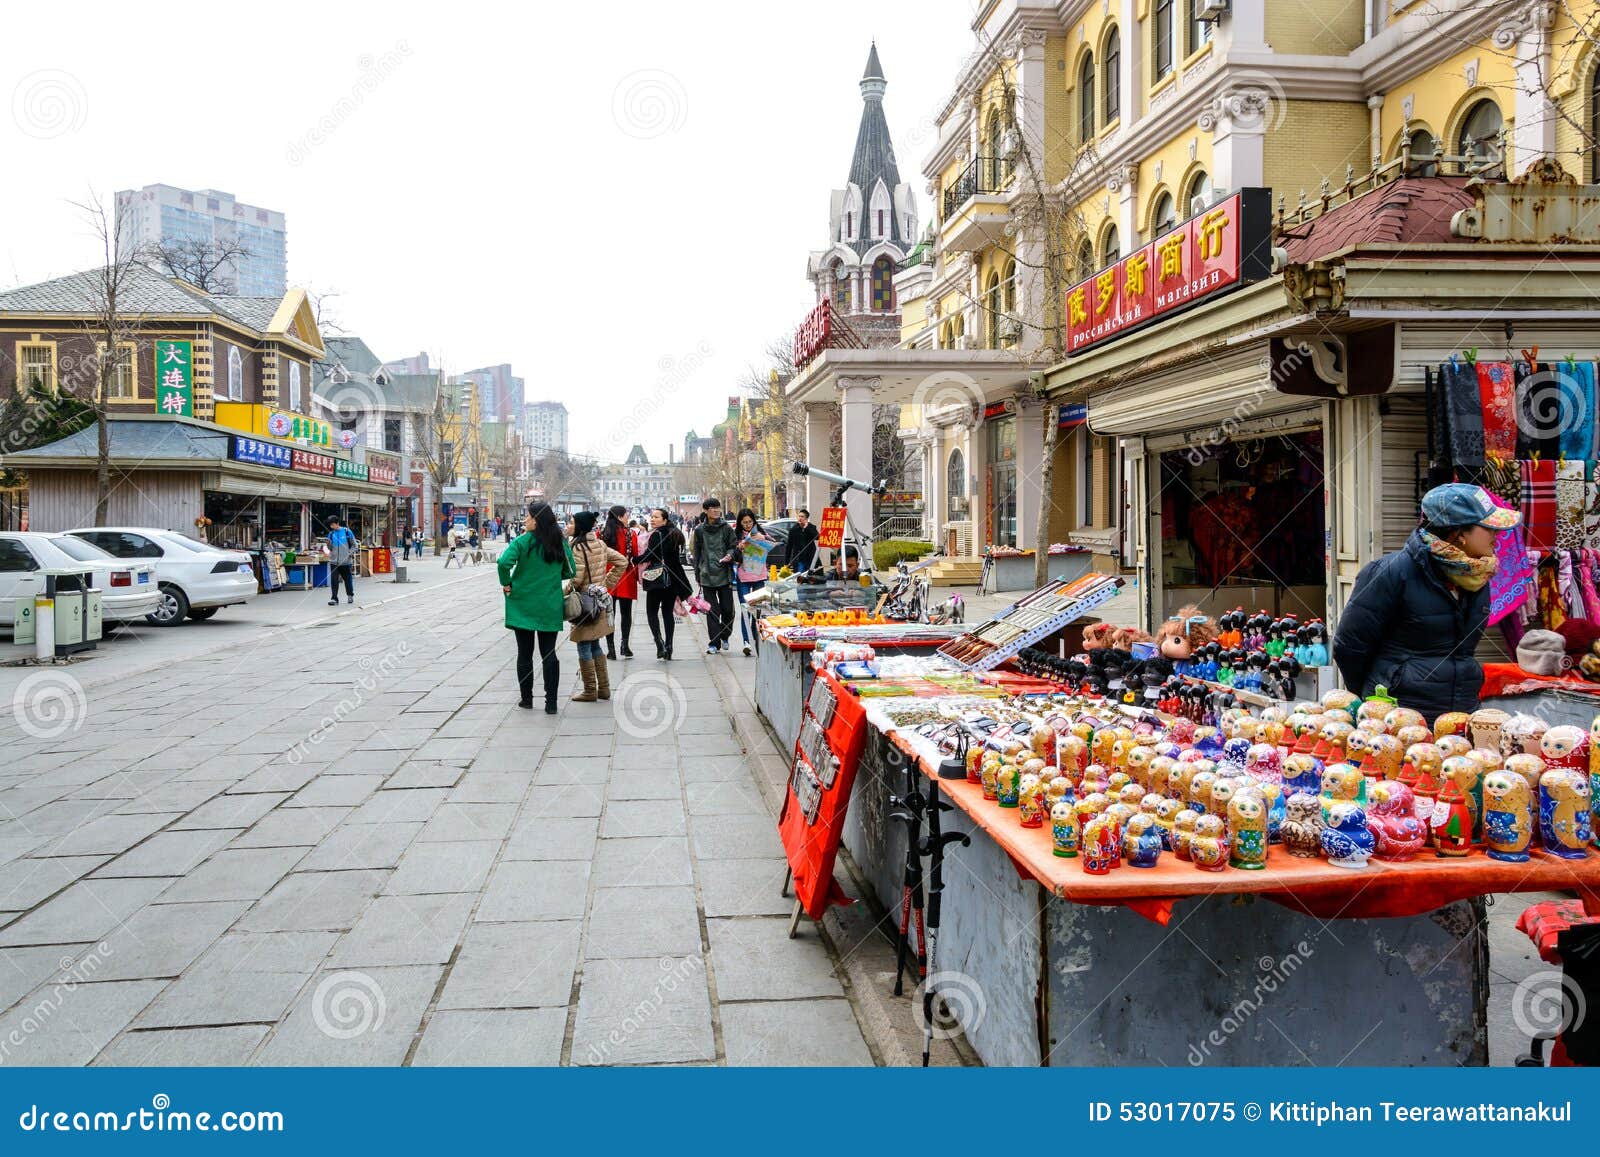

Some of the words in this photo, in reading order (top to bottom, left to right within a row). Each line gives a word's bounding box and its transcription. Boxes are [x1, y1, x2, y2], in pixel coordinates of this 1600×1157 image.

[1068, 208, 1230, 328] 俄罗斯商行
[1157, 270, 1221, 309] магазин
[162, 343, 187, 414] 大连特
